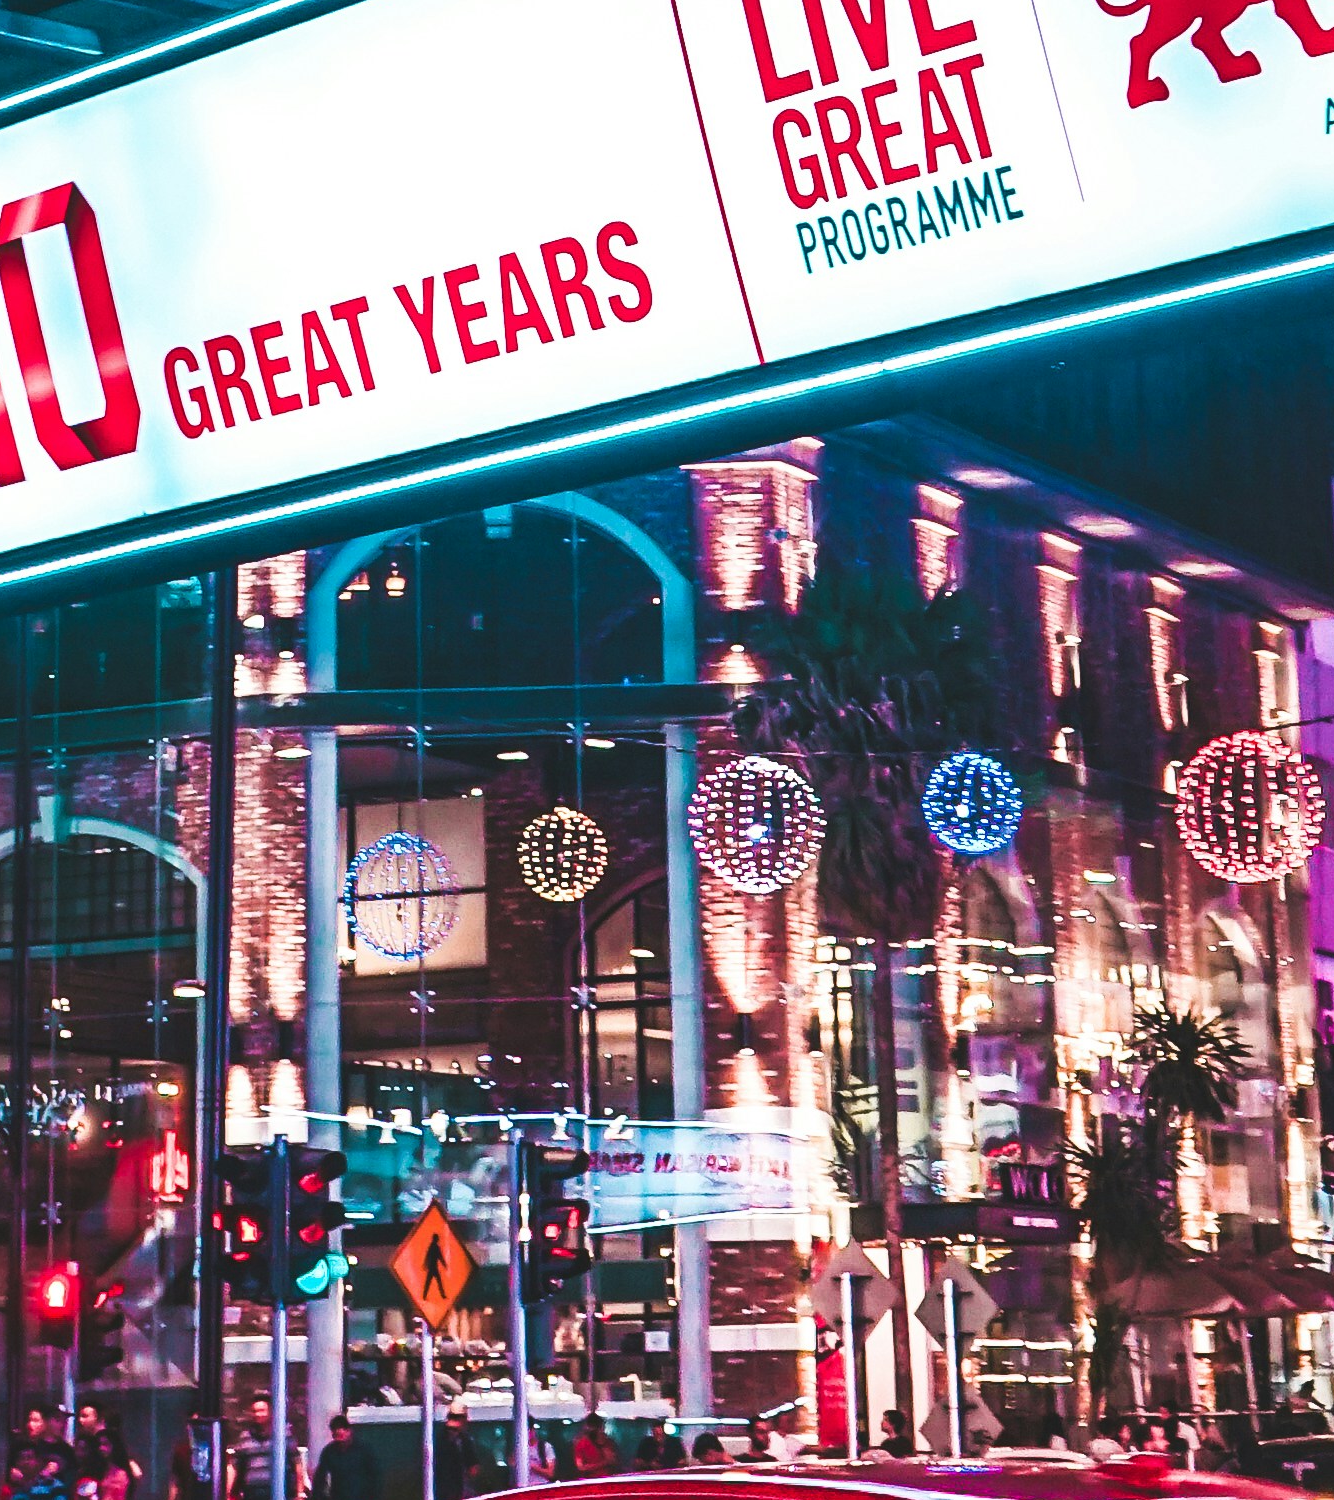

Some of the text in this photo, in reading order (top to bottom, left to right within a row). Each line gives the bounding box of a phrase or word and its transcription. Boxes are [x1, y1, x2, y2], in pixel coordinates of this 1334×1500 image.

[773, 55, 991, 208] GREAT
[796, 166, 1024, 273] PROGRAMME
[164, 297, 375, 438] GREAT
[394, 222, 652, 373] YEARS
